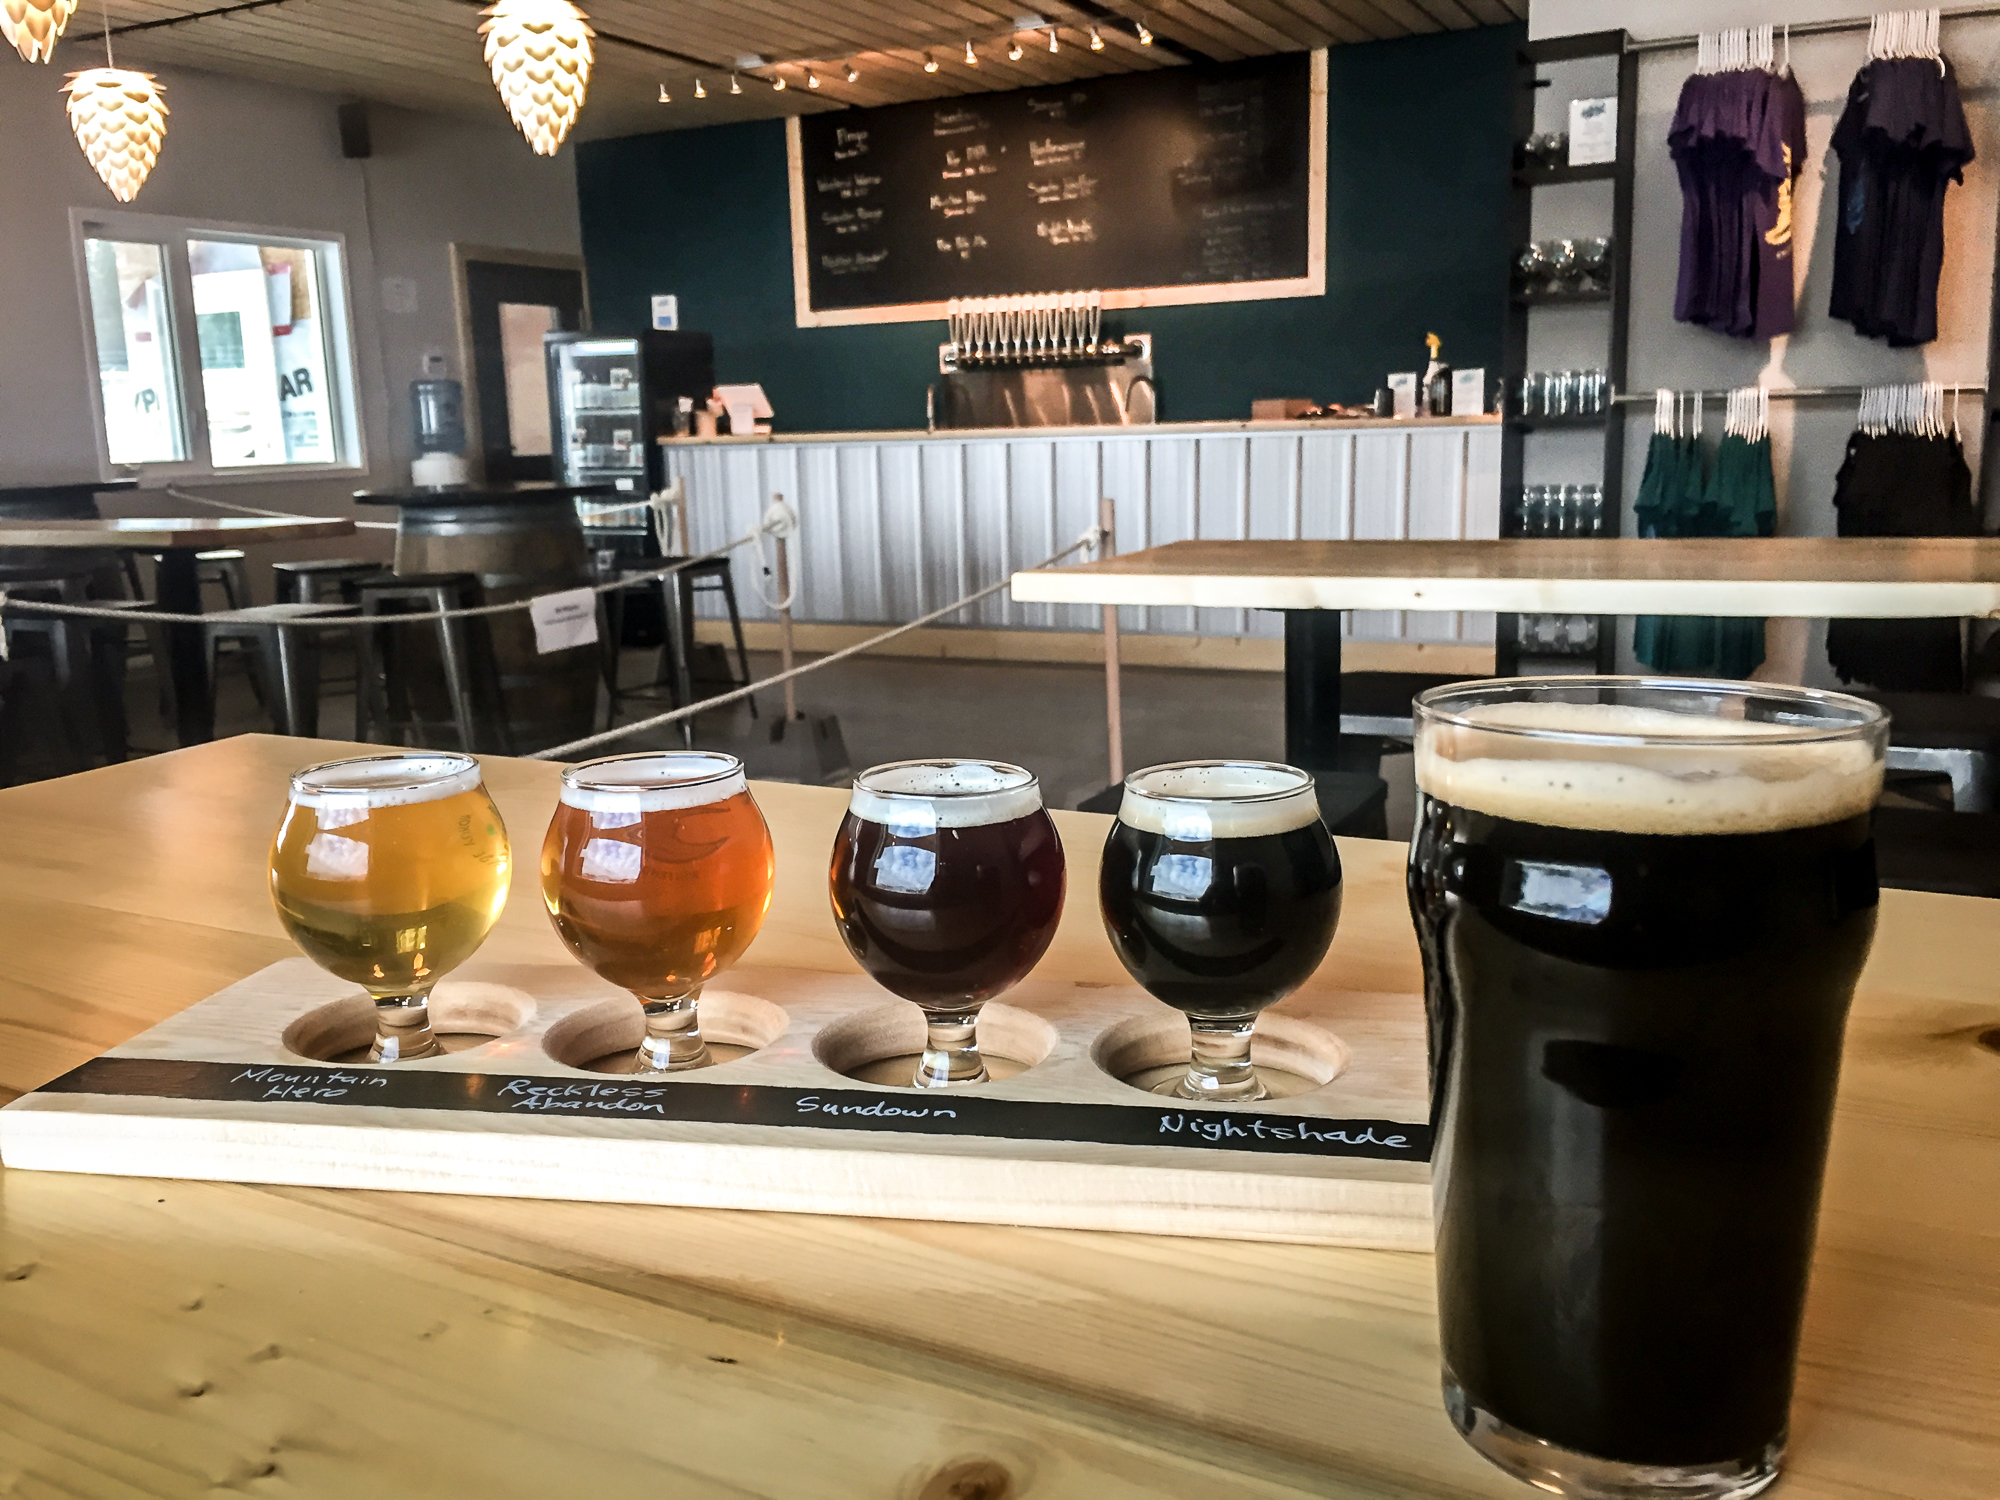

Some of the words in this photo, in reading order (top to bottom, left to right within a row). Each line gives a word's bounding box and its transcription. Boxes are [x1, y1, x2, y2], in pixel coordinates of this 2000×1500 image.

[230, 1067, 388, 1087] Mountain
[262, 1085, 349, 1098] Hero
[497, 1079, 669, 1098] Reckless
[511, 1096, 666, 1114] Abandon
[796, 1096, 957, 1119] Sundown
[1159, 1114, 1413, 1148] Nightshade
